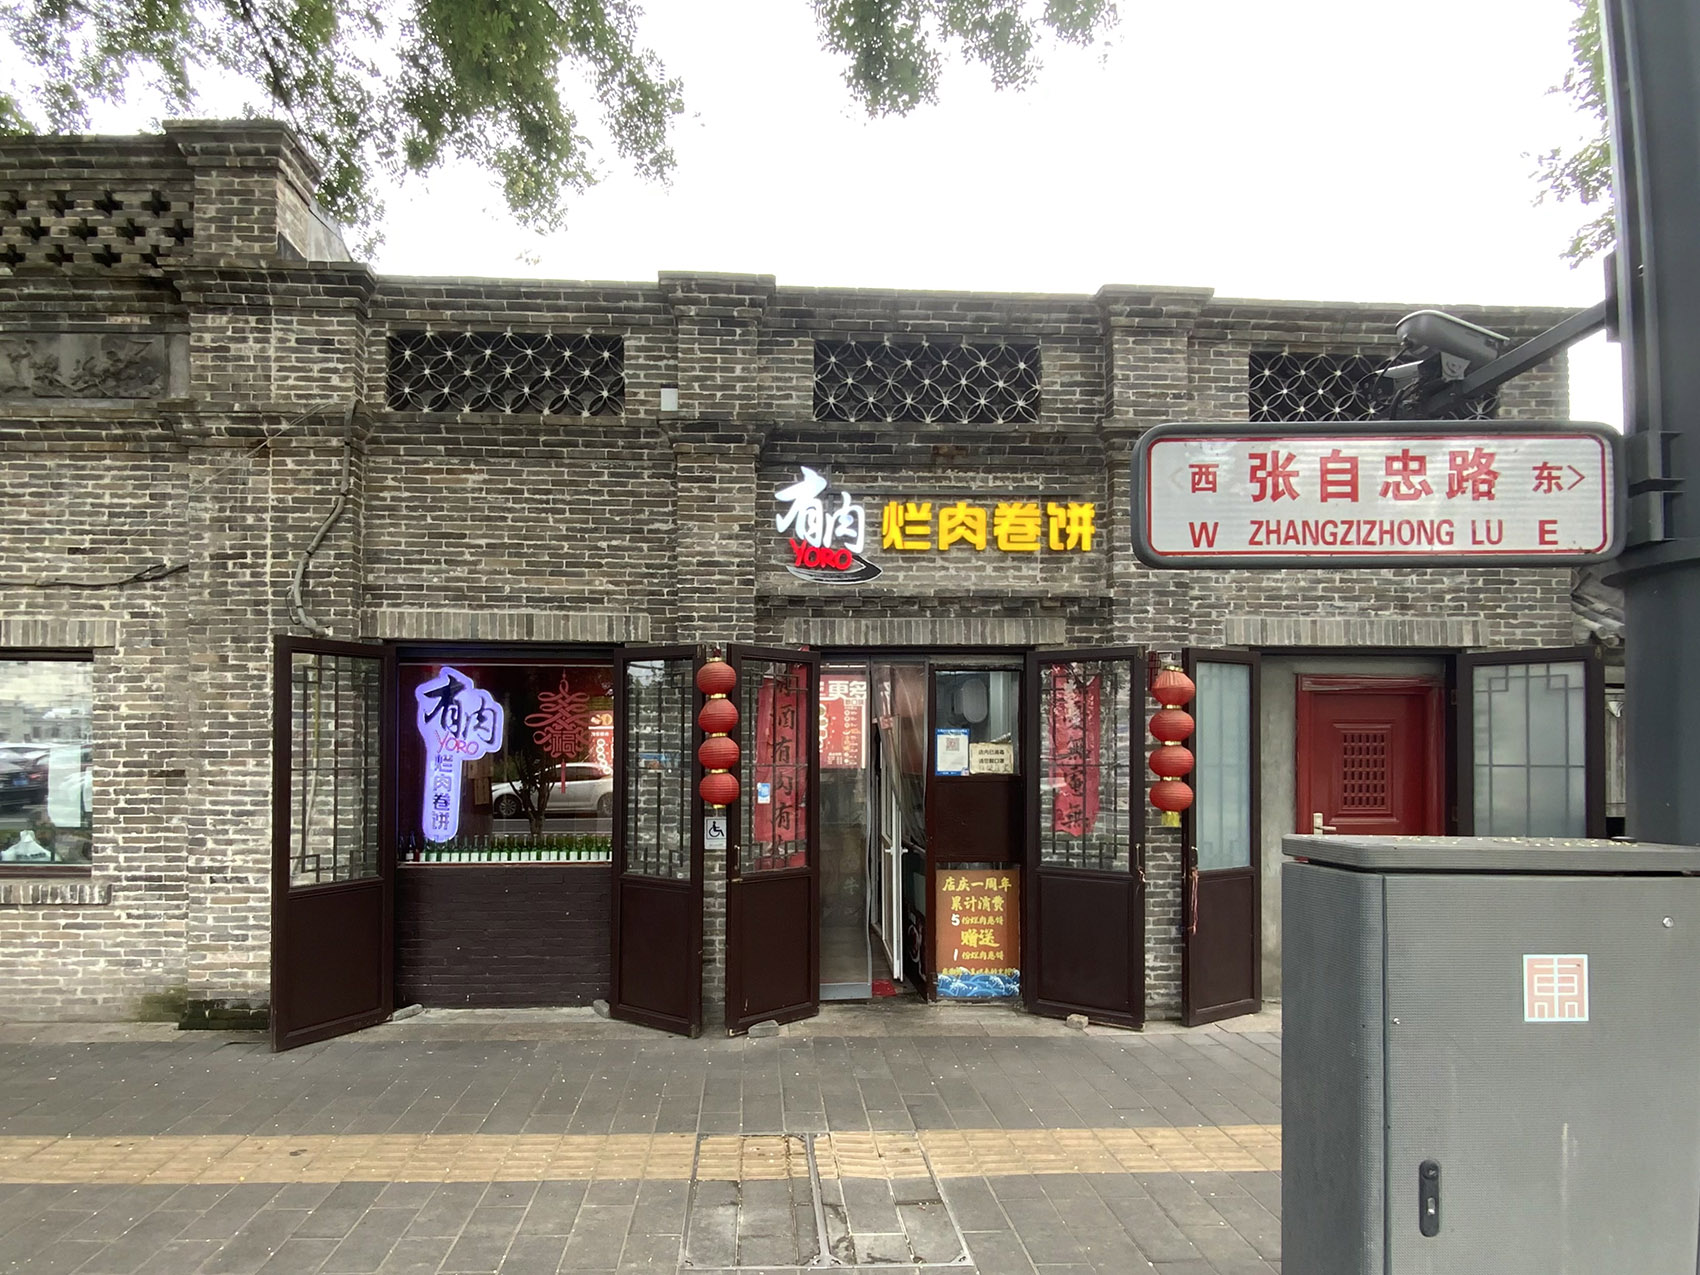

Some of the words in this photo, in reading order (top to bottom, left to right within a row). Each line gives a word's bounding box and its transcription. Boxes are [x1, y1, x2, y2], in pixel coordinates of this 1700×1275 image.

[1189, 463, 1219, 494] 西
[1248, 447, 1501, 503] 张自忠路
[1532, 461, 1563, 493] 东
[775, 466, 866, 554] 有肉
[882, 501, 1096, 552] 烂肉卷饼
[1189, 521, 1220, 548] W
[1248, 518, 1455, 546] ZHANGZIZHONG
[1471, 518, 1504, 546] LU
[1538, 518, 1559, 546] E
[788, 538, 853, 571] YORO
[820, 680, 867, 700] 更多
[423, 674, 497, 745] 有肉
[435, 730, 480, 755] YORO
[433, 754, 454, 831] 烂肉卷饼
[942, 876, 1012, 892] 店庆一周年
[951, 895, 1005, 912] 累计消费
[961, 928, 1000, 948] 赠送
